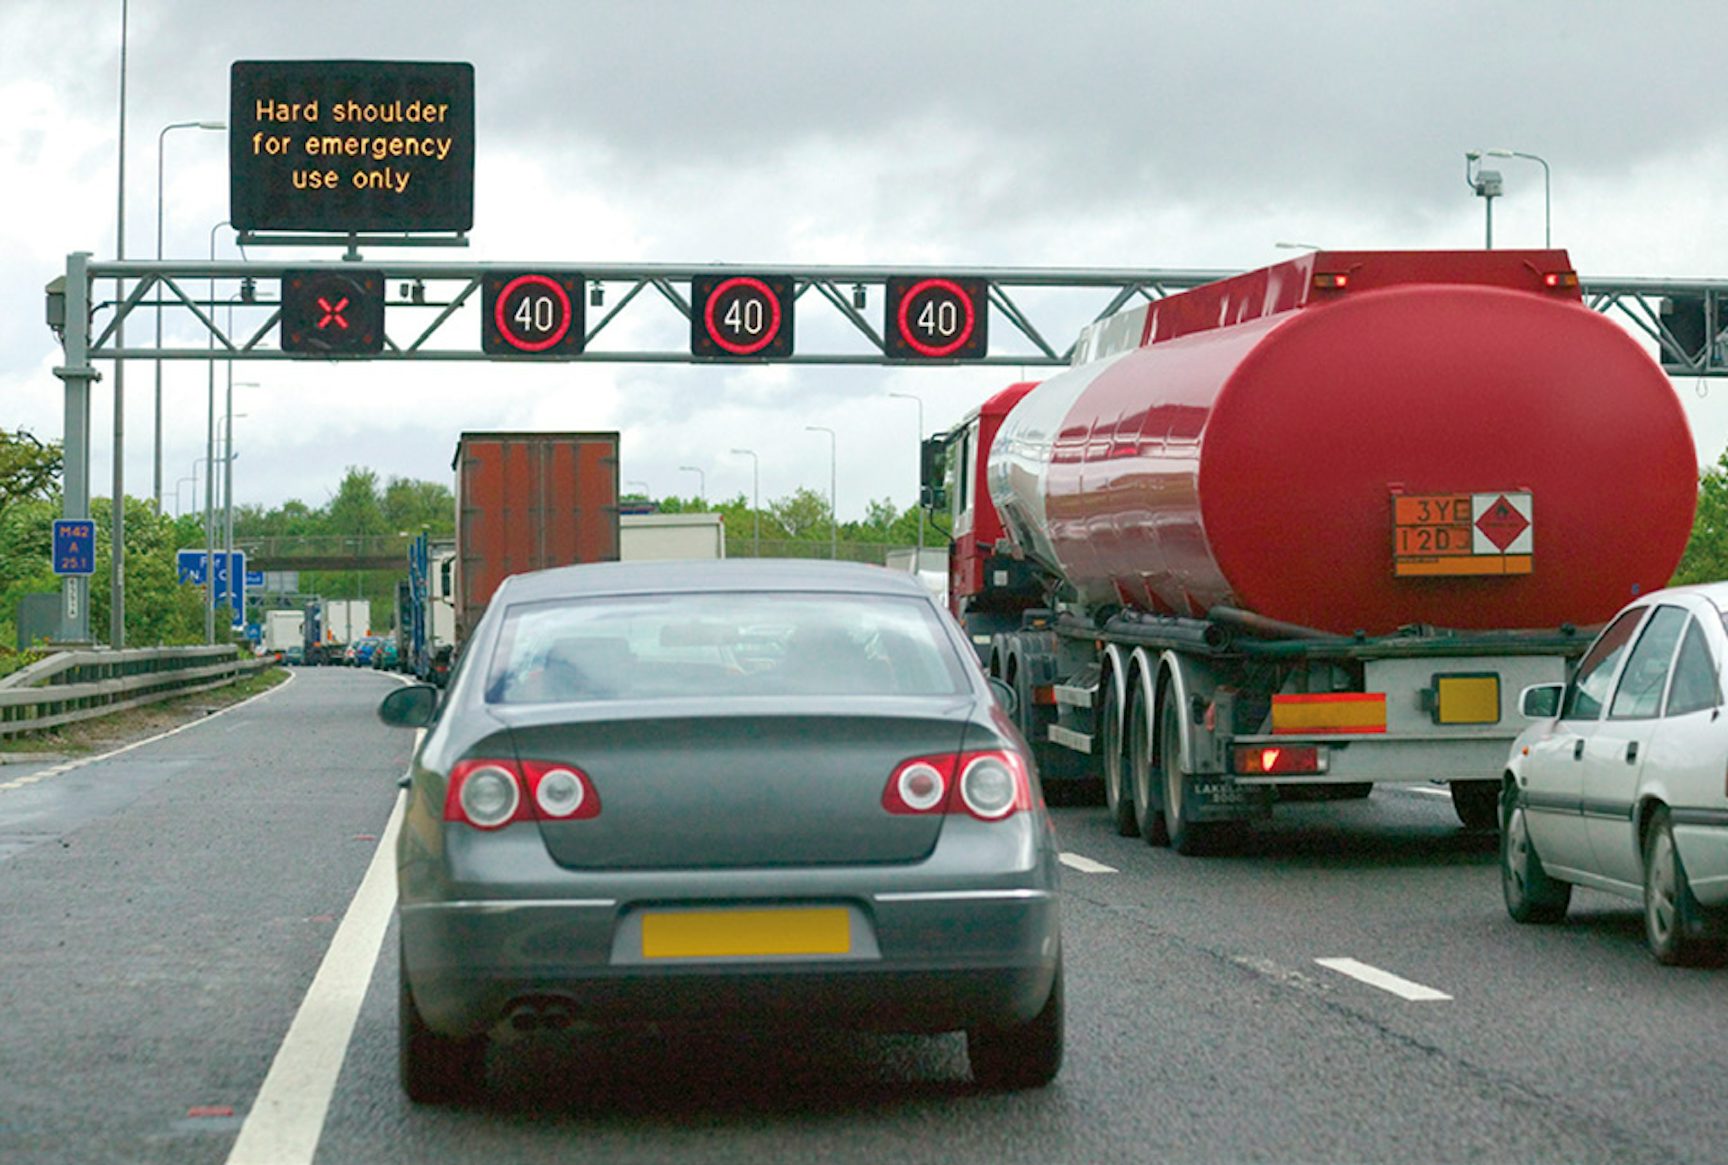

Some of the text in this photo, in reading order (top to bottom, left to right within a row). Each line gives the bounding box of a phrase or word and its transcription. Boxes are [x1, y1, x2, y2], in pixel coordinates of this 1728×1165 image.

[256, 99, 449, 122] Hard shoulder
[252, 132, 452, 160] for emergency
[292, 167, 411, 193] use only
[514, 296, 554, 332] 40
[724, 299, 763, 334] 40
[918, 300, 957, 336] 40
[1418, 499, 1470, 521] 3YE
